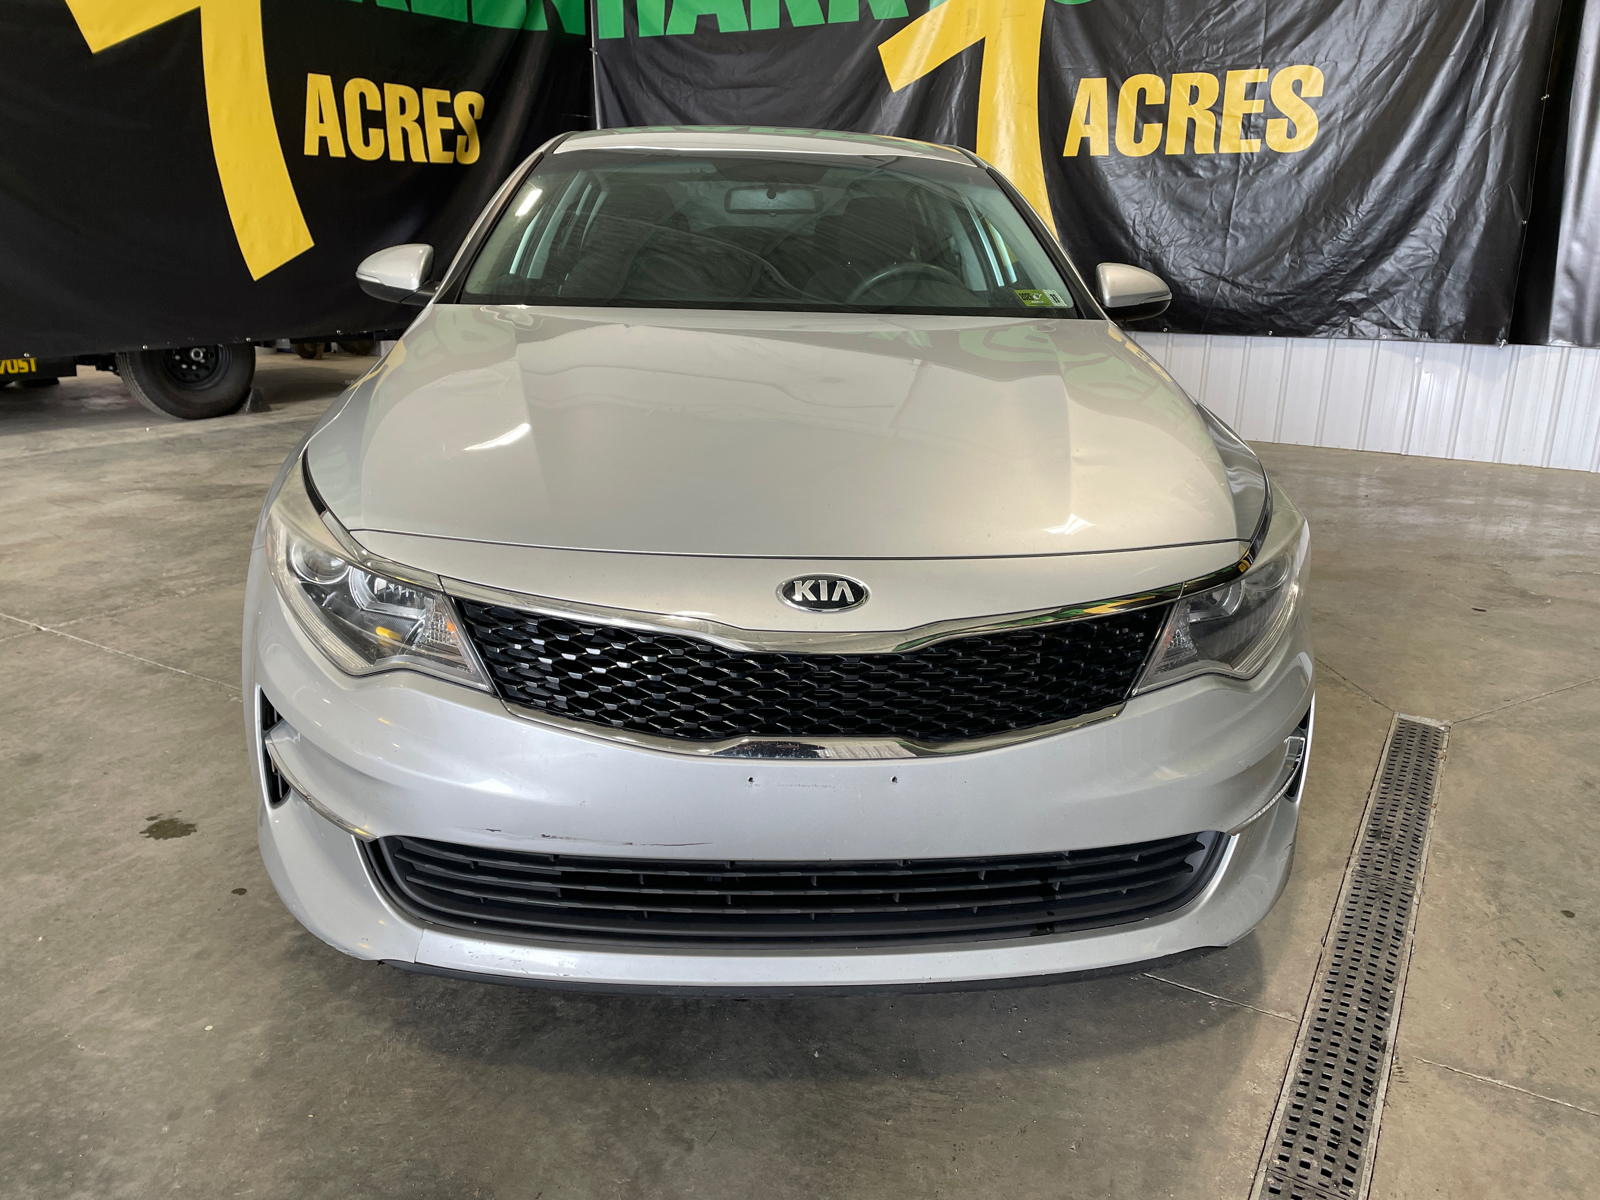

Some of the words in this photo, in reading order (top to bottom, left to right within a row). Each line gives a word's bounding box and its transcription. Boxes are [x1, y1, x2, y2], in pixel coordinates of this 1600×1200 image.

[303, 73, 485, 165] ACRES
[1063, 65, 1324, 157] ACRES
[792, 580, 855, 602] KIA
